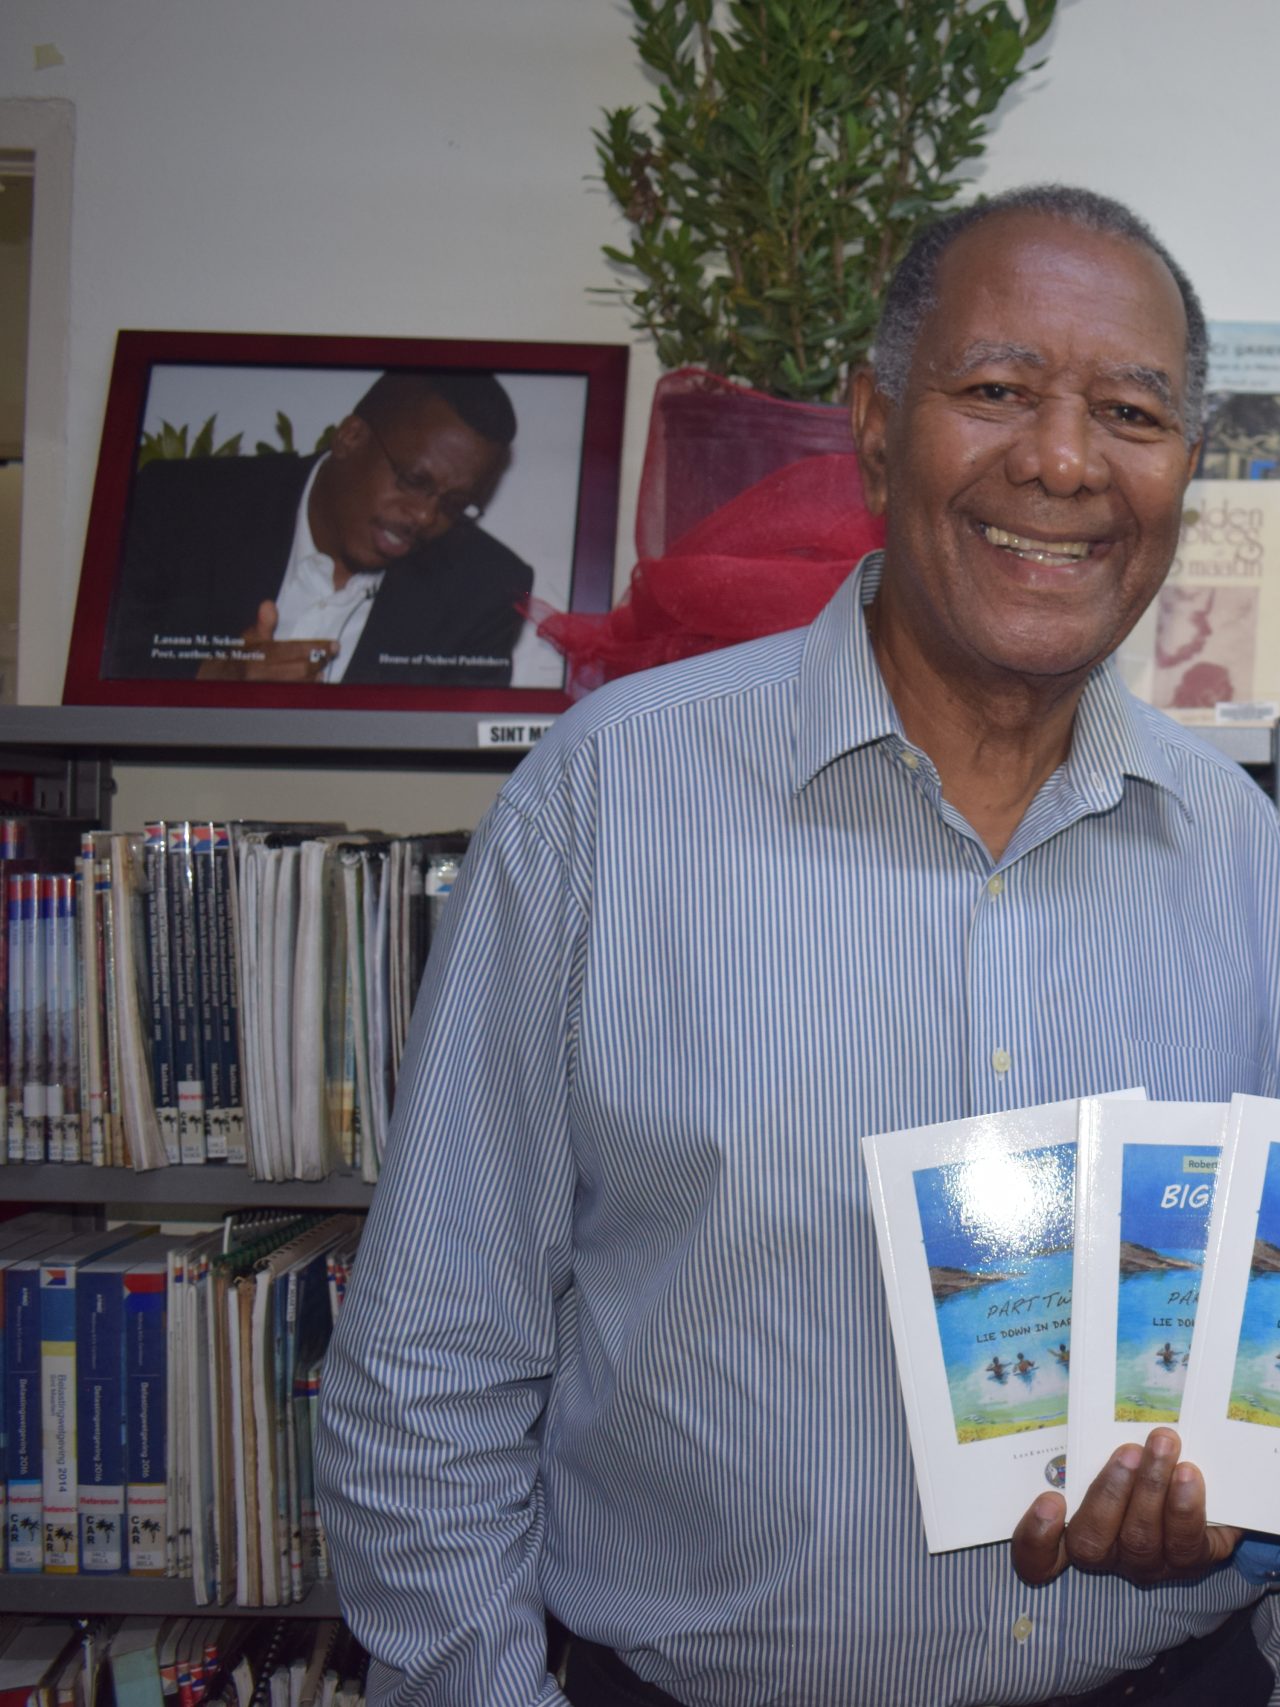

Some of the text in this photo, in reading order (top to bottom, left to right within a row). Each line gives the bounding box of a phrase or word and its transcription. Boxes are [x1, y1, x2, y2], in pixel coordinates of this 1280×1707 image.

[490, 727, 549, 742] SINT M
[1160, 1184, 1209, 1209] BIG
[987, 1295, 1041, 1319] PART
[976, 1332, 996, 1343] LIE
[1001, 1326, 1031, 1339] DOWN
[1035, 1322, 1049, 1333] IN
[1152, 1317, 1173, 1327] LIE
[19, 1378, 29, 1475] Belastingwetgeving 2016
[56, 1374, 68, 1493] Belastingwetgeving 2014
[93, 1385, 103, 1482] Belastingwetgeving 2016
[140, 1382, 150, 1478] Belastingwetgeving 2016
[11, 1513, 19, 1542] CAR
[45, 1523, 54, 1552] CAR
[86, 1515, 95, 1544] CAR
[131, 1515, 140, 1544] CAR
